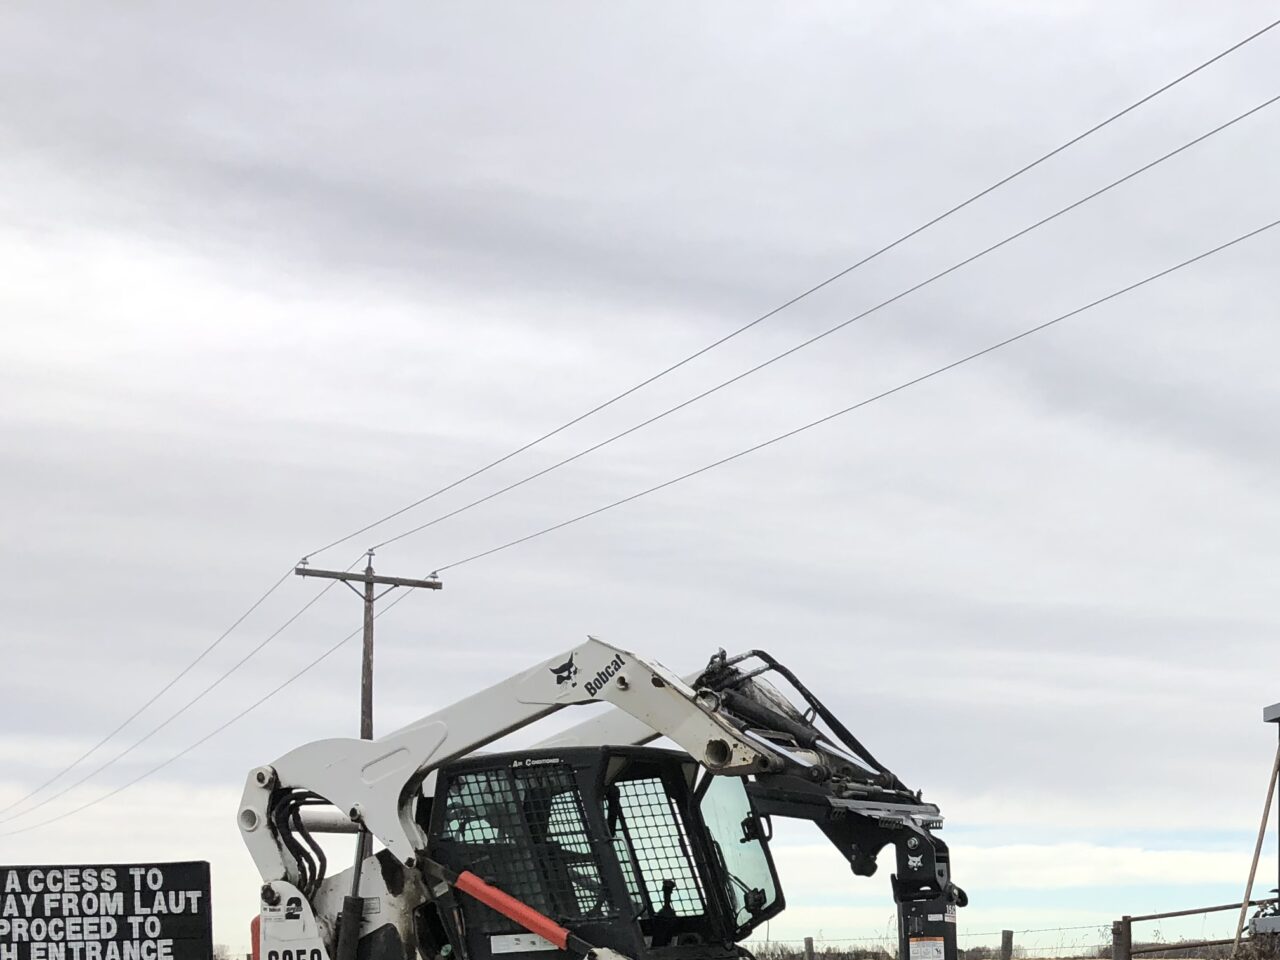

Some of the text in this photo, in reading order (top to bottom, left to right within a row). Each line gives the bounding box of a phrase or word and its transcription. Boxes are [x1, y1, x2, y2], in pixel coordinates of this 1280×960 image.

[584, 653, 626, 697] Bobcat
[4, 867, 164, 893] ACCESS TO
[0, 890, 202, 917] AY FROM LAUT
[0, 916, 162, 942] PROCEED TO
